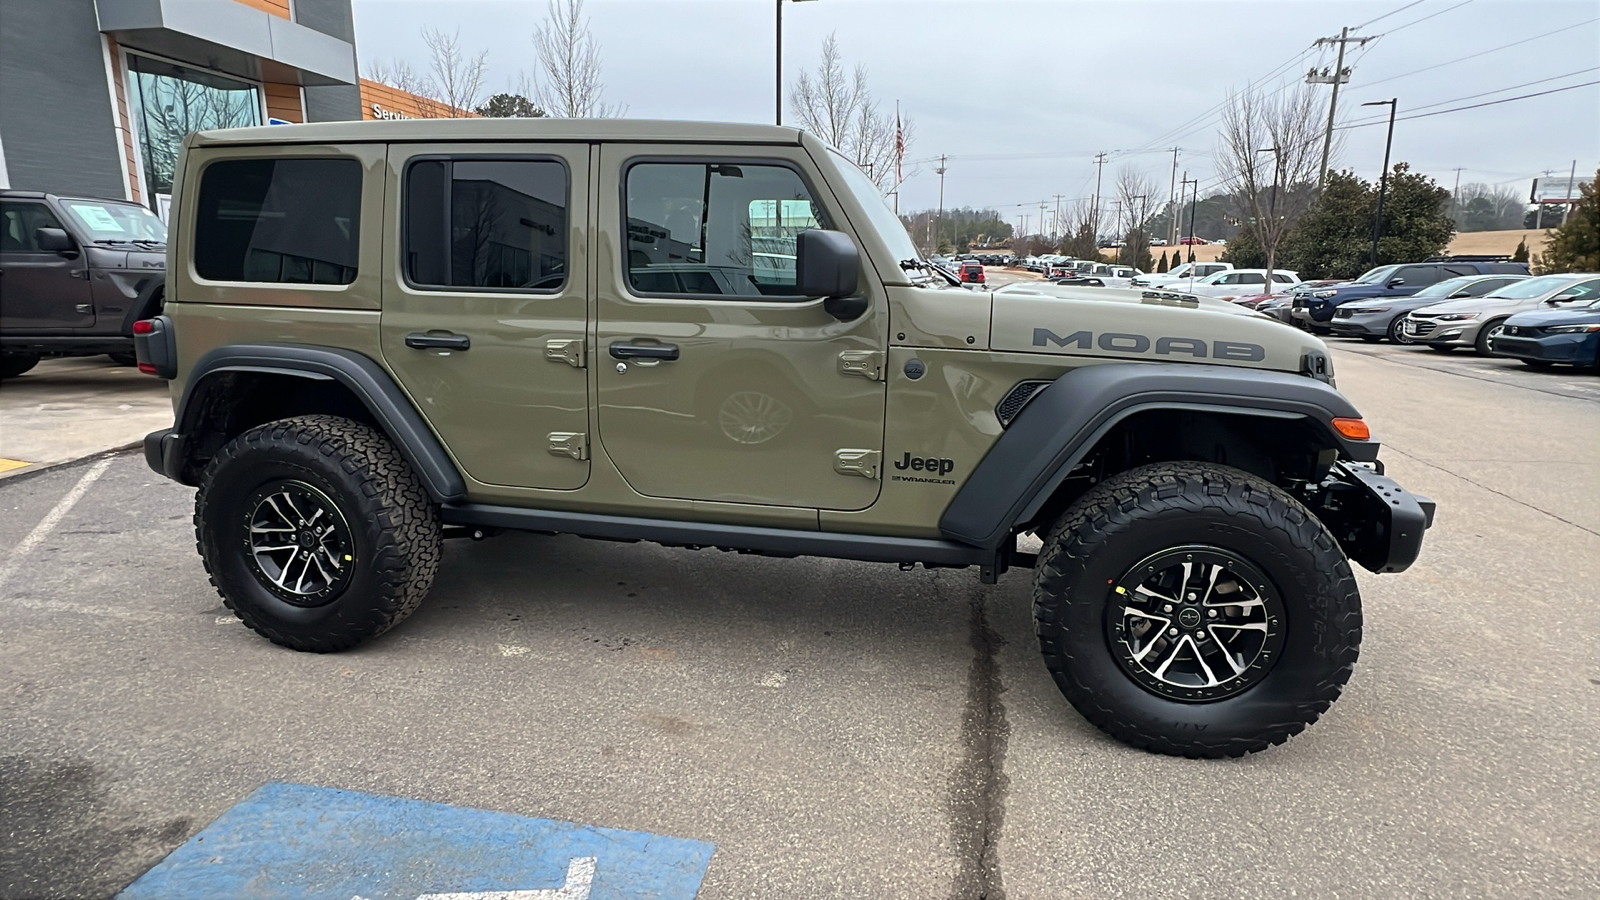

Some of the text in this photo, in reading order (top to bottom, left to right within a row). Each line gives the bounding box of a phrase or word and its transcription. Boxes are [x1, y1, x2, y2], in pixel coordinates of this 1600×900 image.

[1032, 328, 1265, 362] MOAB
[894, 451, 954, 476] Jeep
[901, 476, 955, 485] WRANGLER
